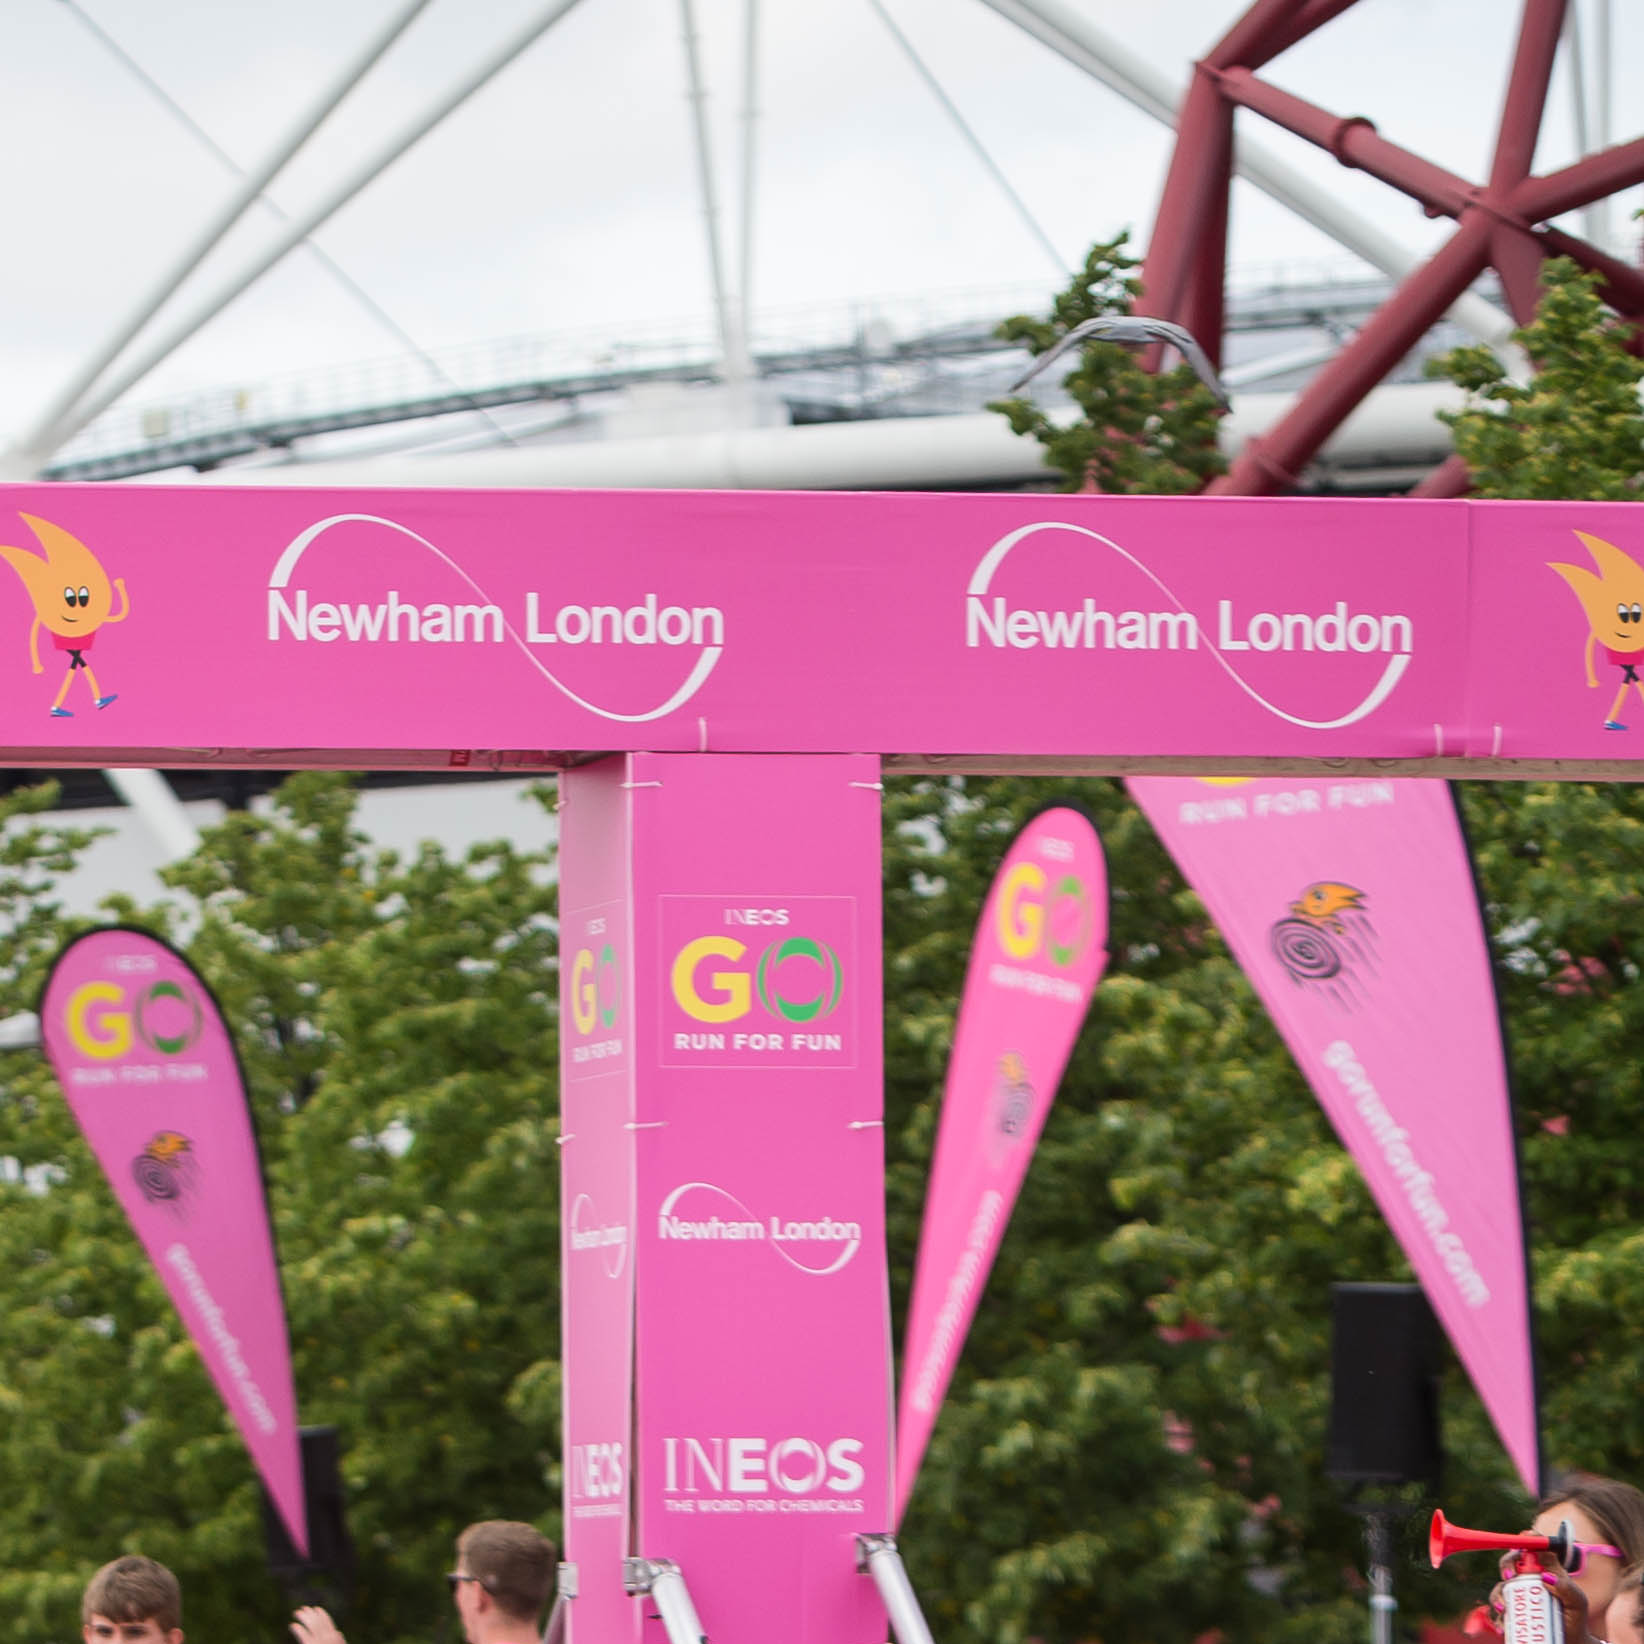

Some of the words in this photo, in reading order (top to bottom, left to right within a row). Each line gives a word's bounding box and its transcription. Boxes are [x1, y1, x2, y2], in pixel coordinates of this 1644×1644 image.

[267, 592, 504, 644] Newham
[527, 594, 725, 649] London
[965, 596, 1199, 649] Newham
[1218, 600, 1414, 654] London
[1180, 798, 1246, 825] RUN
[1253, 790, 1321, 818] FOR
[1328, 783, 1394, 810] FUN
[724, 909, 790, 927] INEOS
[995, 862, 1095, 967] GO
[670, 935, 843, 1025] GO
[67, 980, 204, 1060] GO
[674, 1032, 725, 1052] RUN
[733, 1032, 783, 1052] FOR
[791, 1033, 842, 1052] FUN
[1320, 1039, 1491, 1309] gorunforfun.com
[659, 1216, 763, 1241] Newham
[771, 1216, 861, 1242] London
[663, 1437, 866, 1495] INEOS
